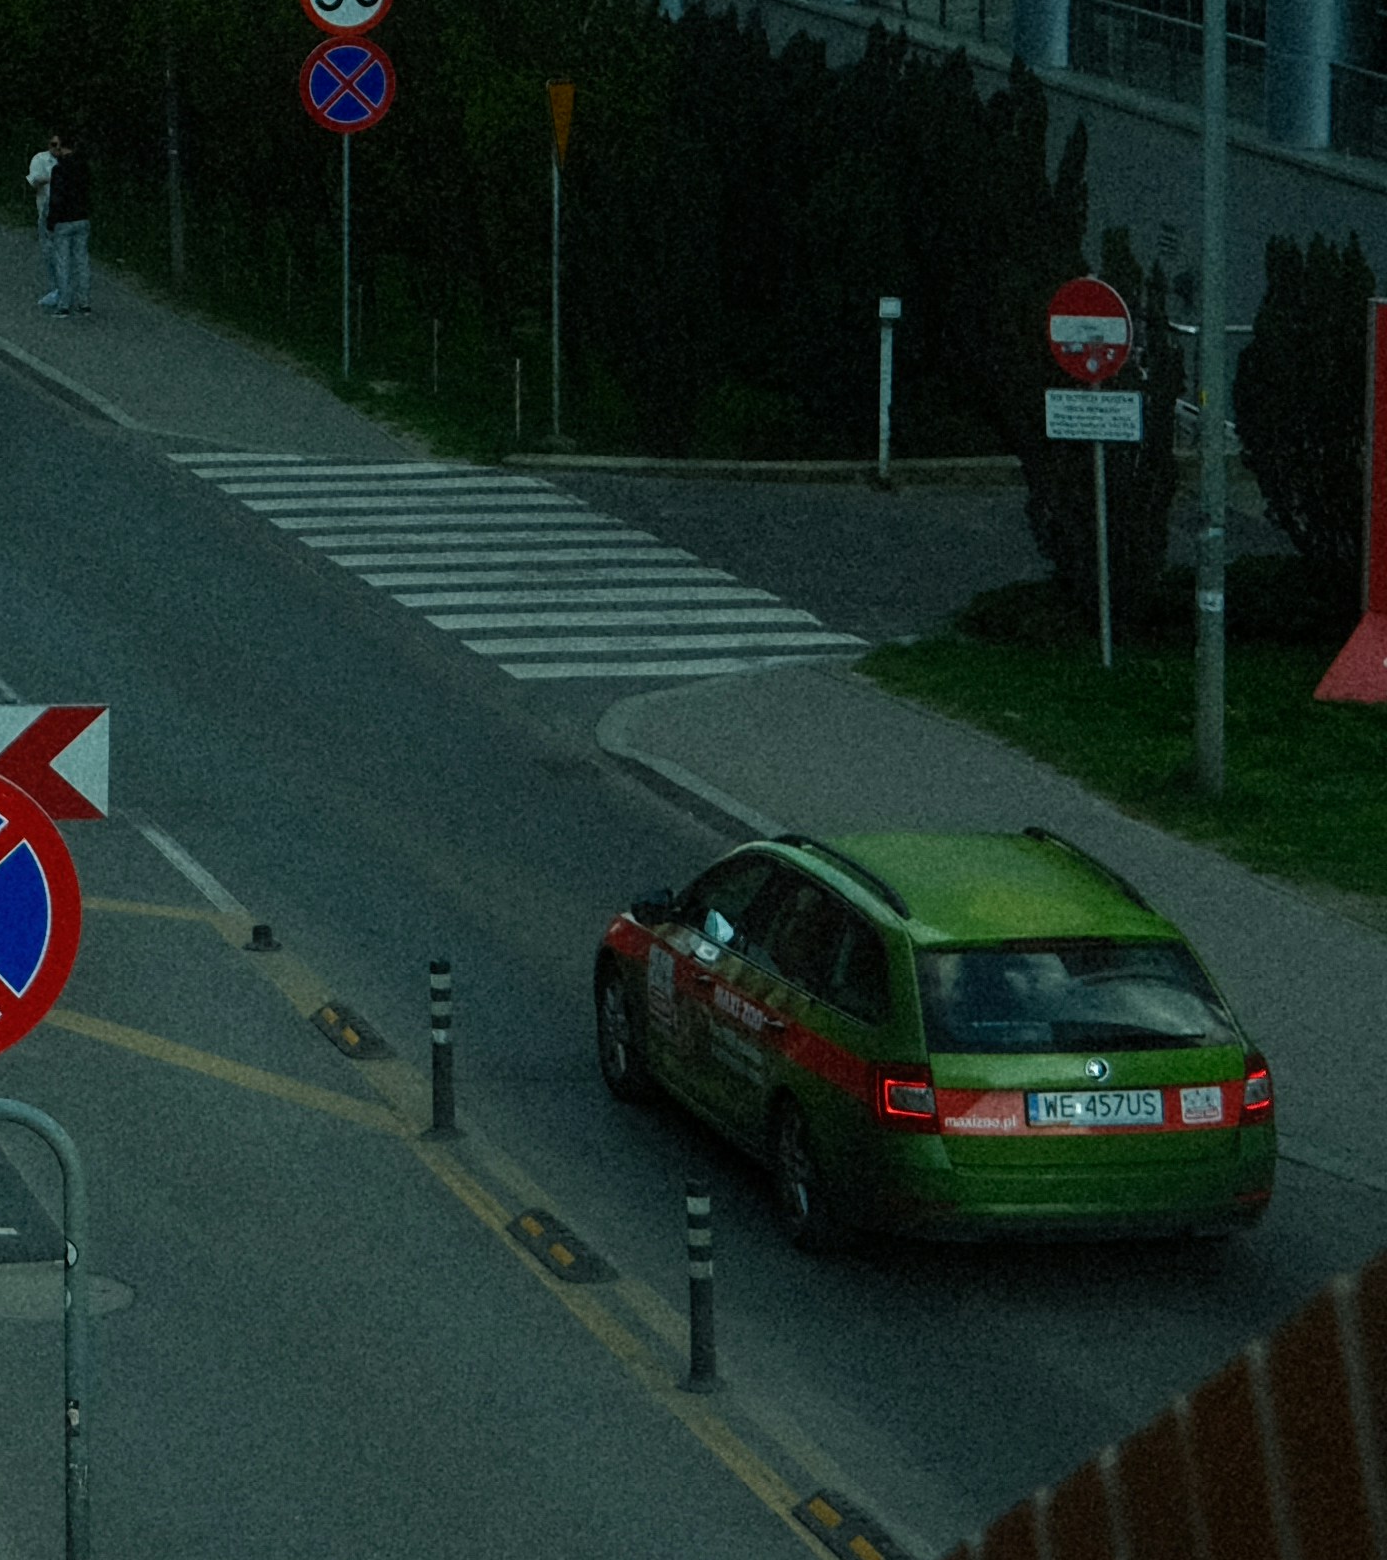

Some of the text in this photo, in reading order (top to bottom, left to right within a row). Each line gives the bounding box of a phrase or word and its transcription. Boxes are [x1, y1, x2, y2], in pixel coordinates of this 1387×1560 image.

[1043, 1094, 1075, 1118] WE
[1085, 1092, 1157, 1117] 457US
[943, 1114, 1018, 1131] maxizoo.pl
